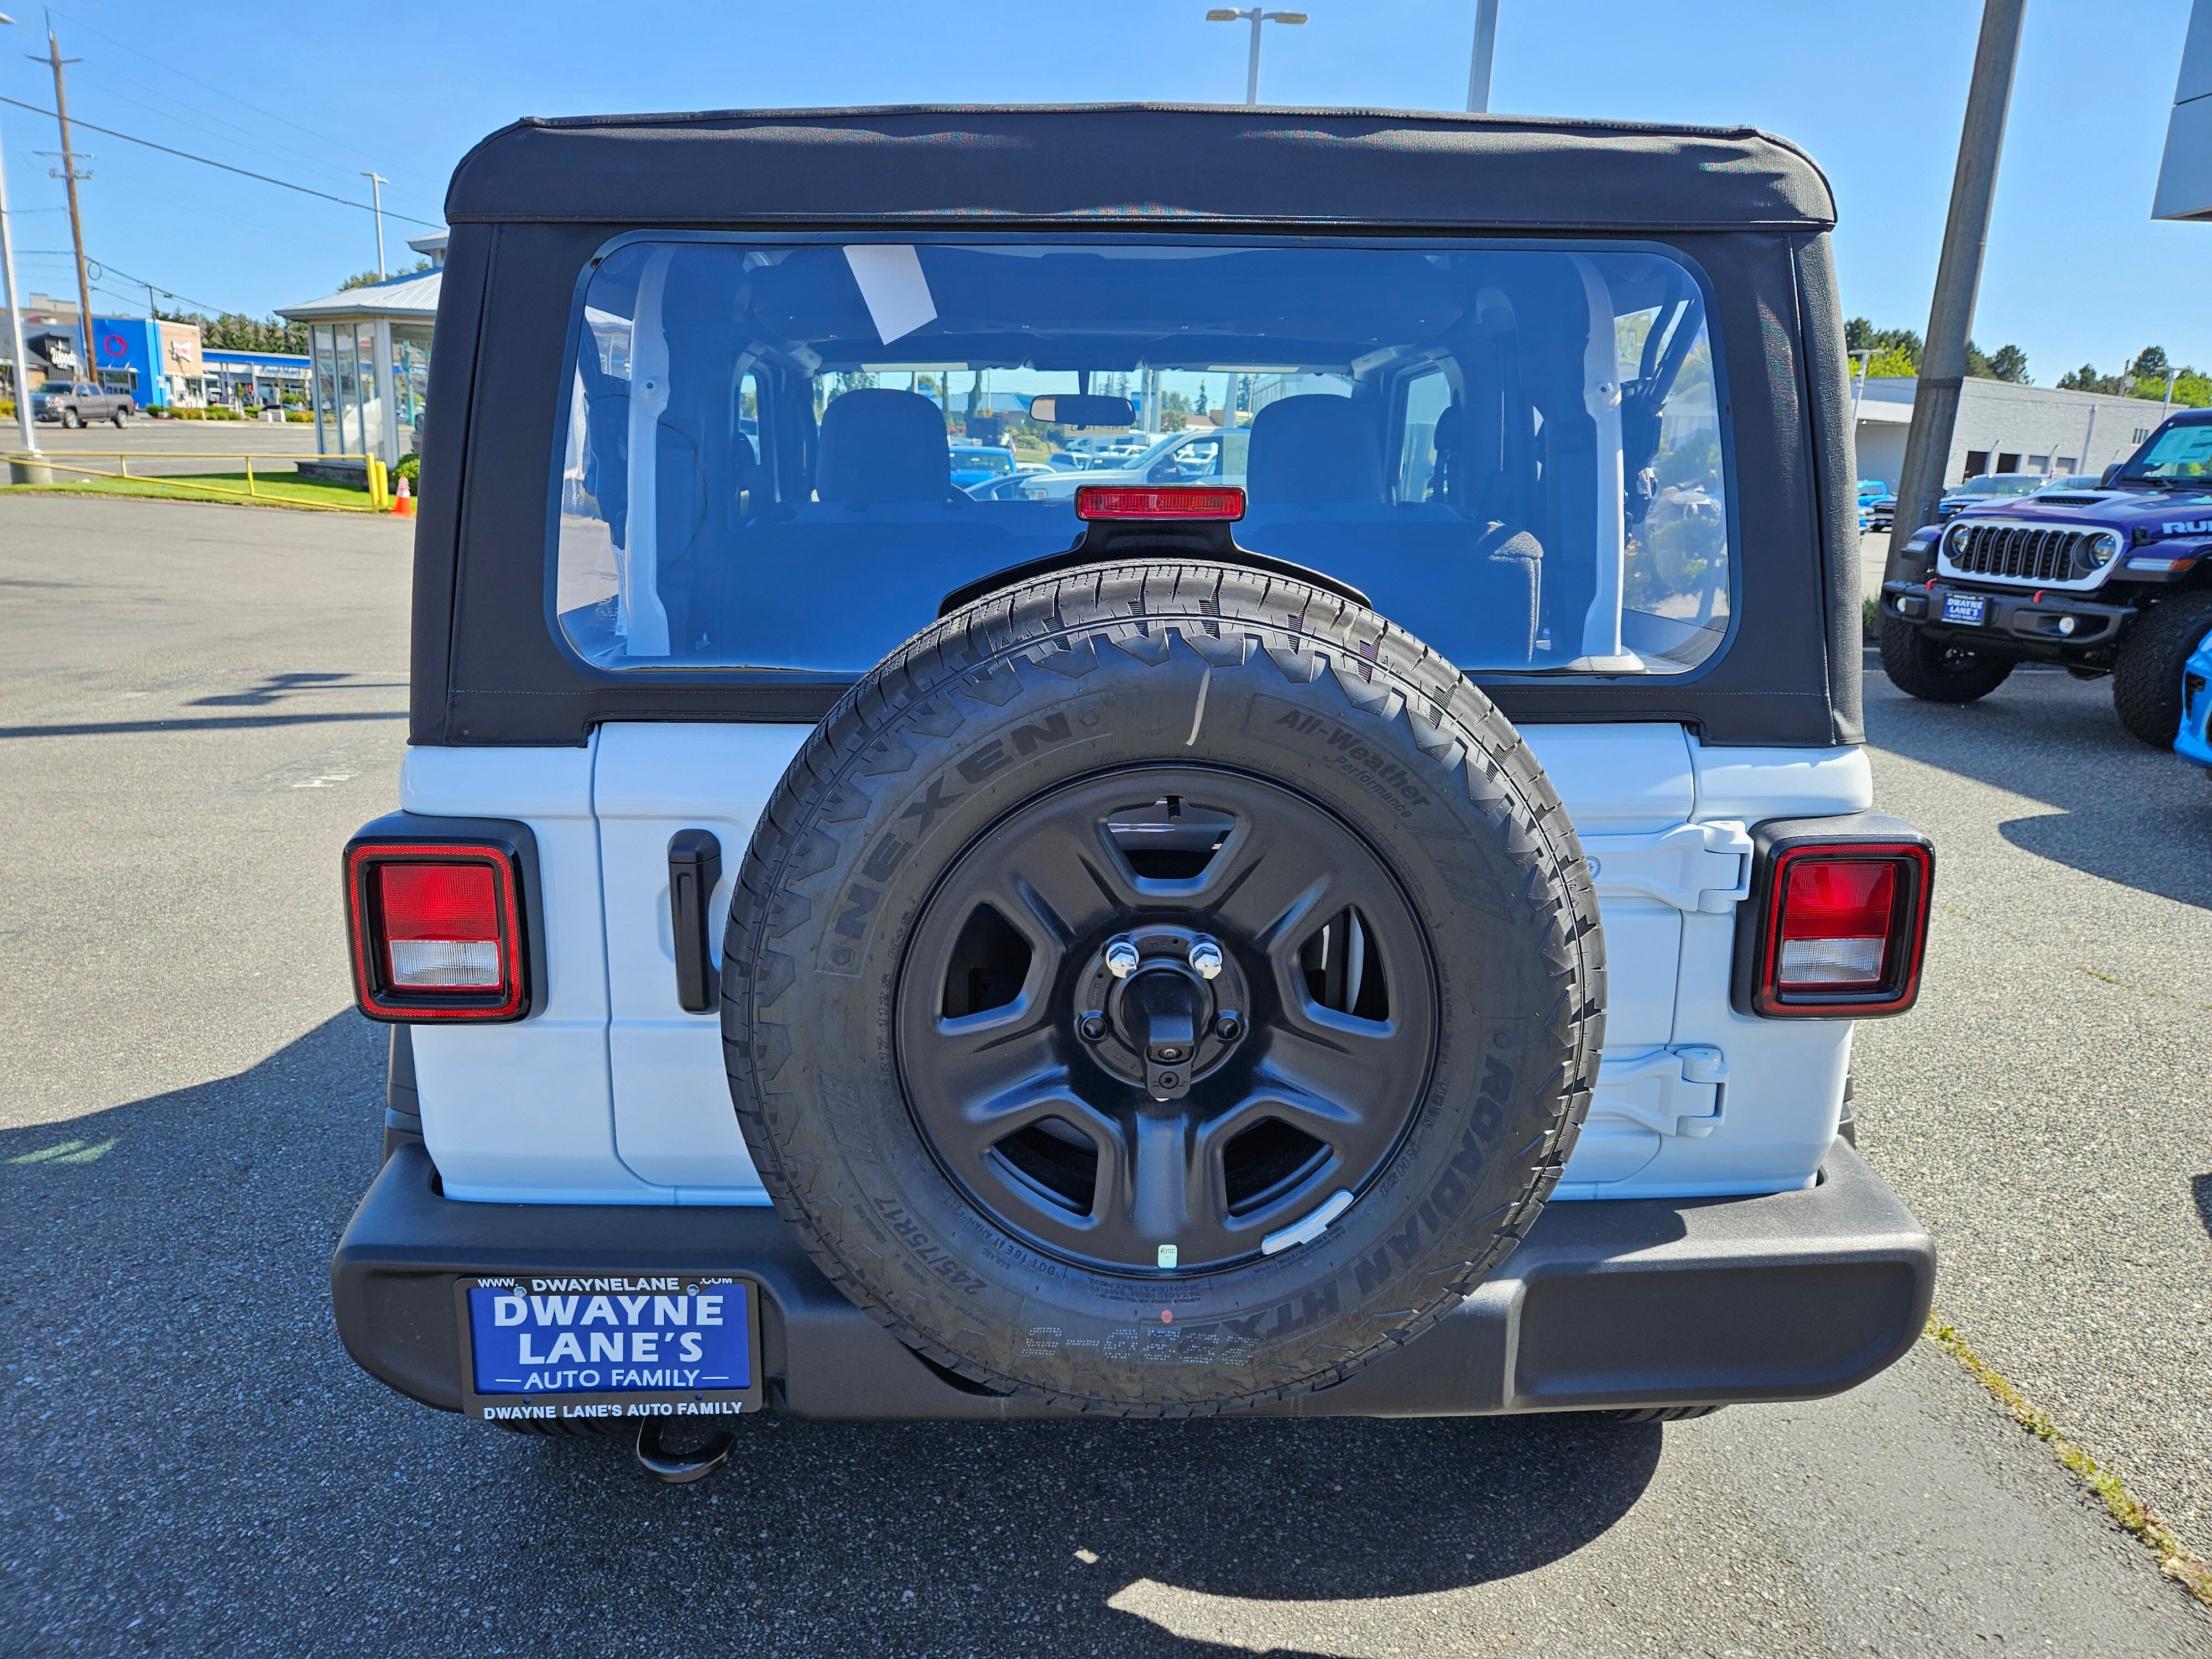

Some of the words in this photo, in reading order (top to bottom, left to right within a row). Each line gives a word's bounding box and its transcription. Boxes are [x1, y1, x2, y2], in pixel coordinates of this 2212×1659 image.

[50, 347, 77, 366] Woods
[2162, 520, 2212, 534] RU
[1276, 710, 1431, 808] All-Weather
[1335, 756, 1413, 819] Performance
[834, 711, 1073, 941] NEXEN
[1353, 1054, 1514, 1294] ROADIAN
[874, 1197, 988, 1296] 245/75R17
[1031, 1259, 1056, 1276] DOT
[533, 1278, 680, 1291] DWAYNELANE
[494, 1296, 723, 1326] DWAYNE
[519, 1332, 703, 1364] LANE'S
[523, 1370, 600, 1390] AUTO
[611, 1369, 700, 1386] FAMILY
[483, 1406, 556, 1420] DWAYNE
[563, 1405, 622, 1418] LANE'S
[627, 1404, 673, 1416] AUTO
[677, 1401, 742, 1415] FAMILY
